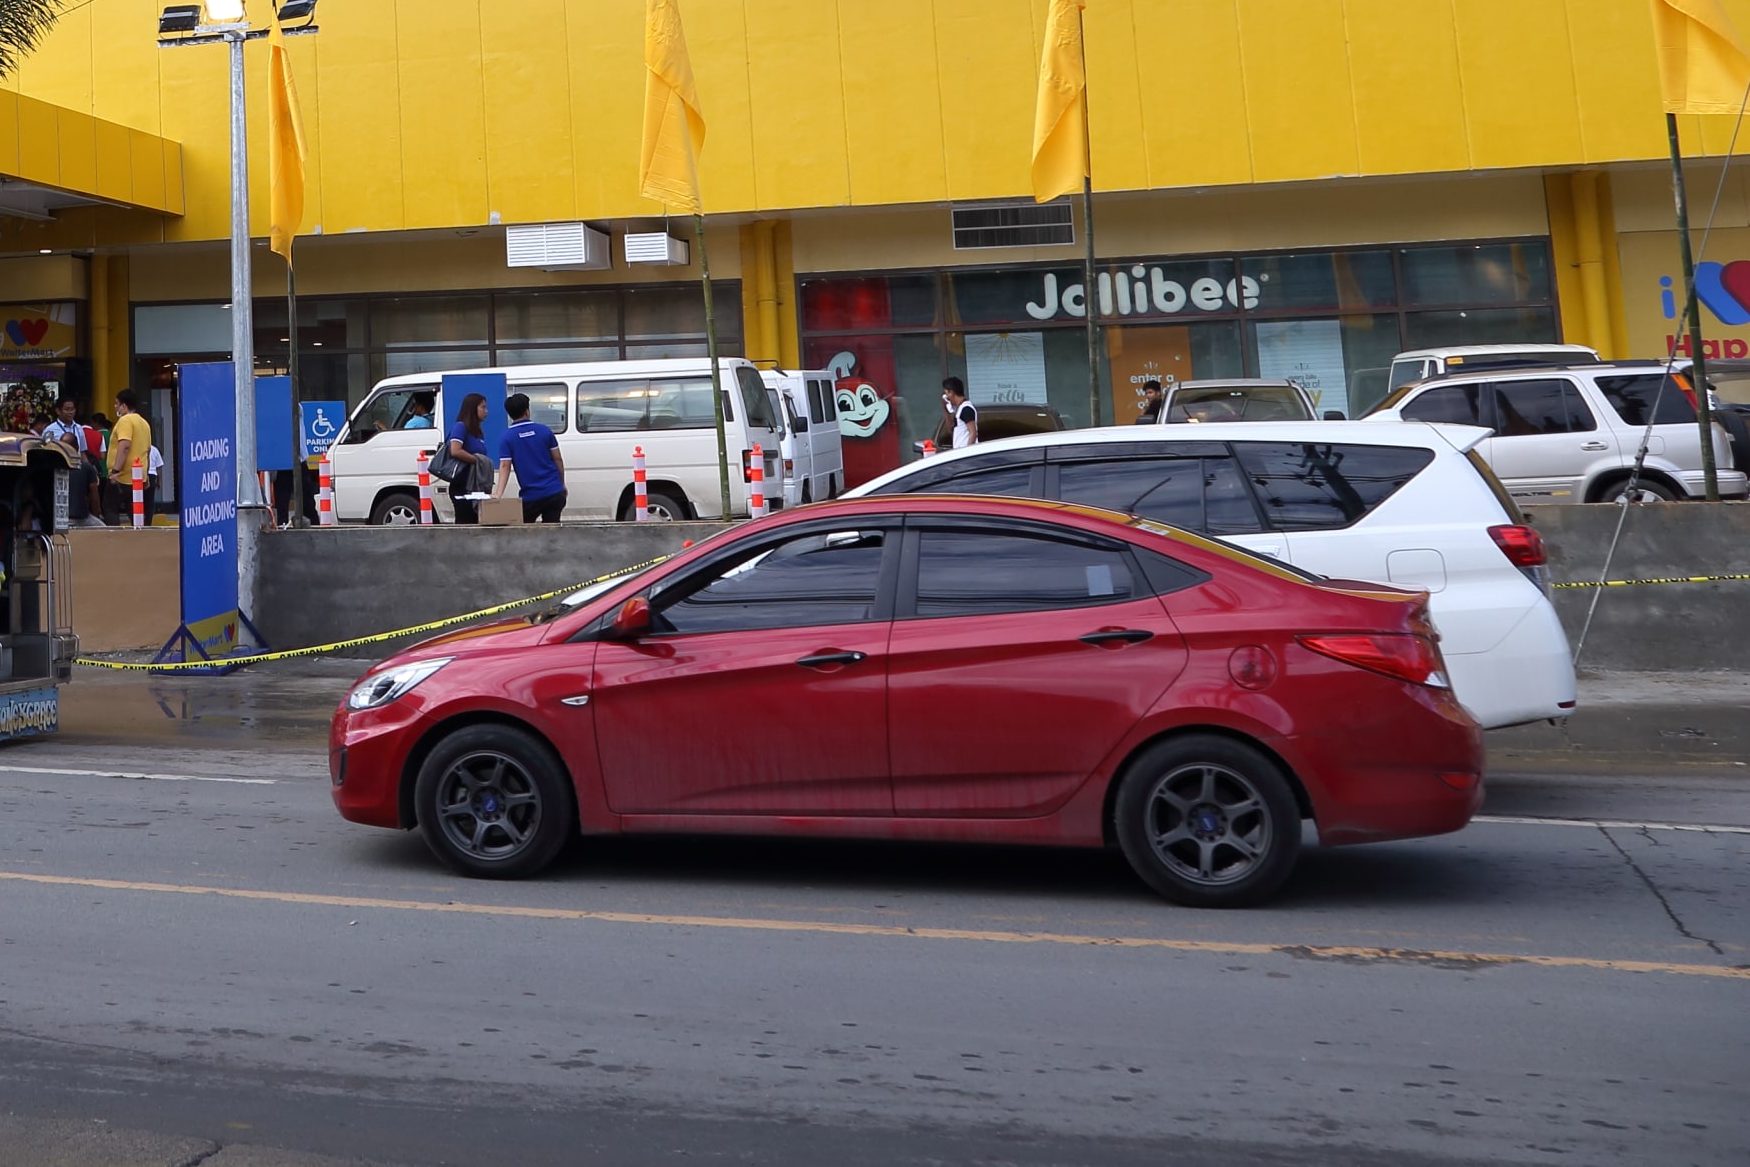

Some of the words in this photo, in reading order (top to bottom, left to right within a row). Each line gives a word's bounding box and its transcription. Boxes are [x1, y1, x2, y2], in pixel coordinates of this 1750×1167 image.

[1026, 265, 1260, 320] Jollibee
[1659, 275, 1676, 319] i
[1666, 334, 1749, 360] Hap
[1130, 373, 1162, 383] enter
[1166, 374, 1174, 383] a
[190, 437, 229, 462] LOADING
[200, 471, 220, 493] AND
[185, 499, 235, 528] UNLOADING
[200, 533, 224, 558] AREA
